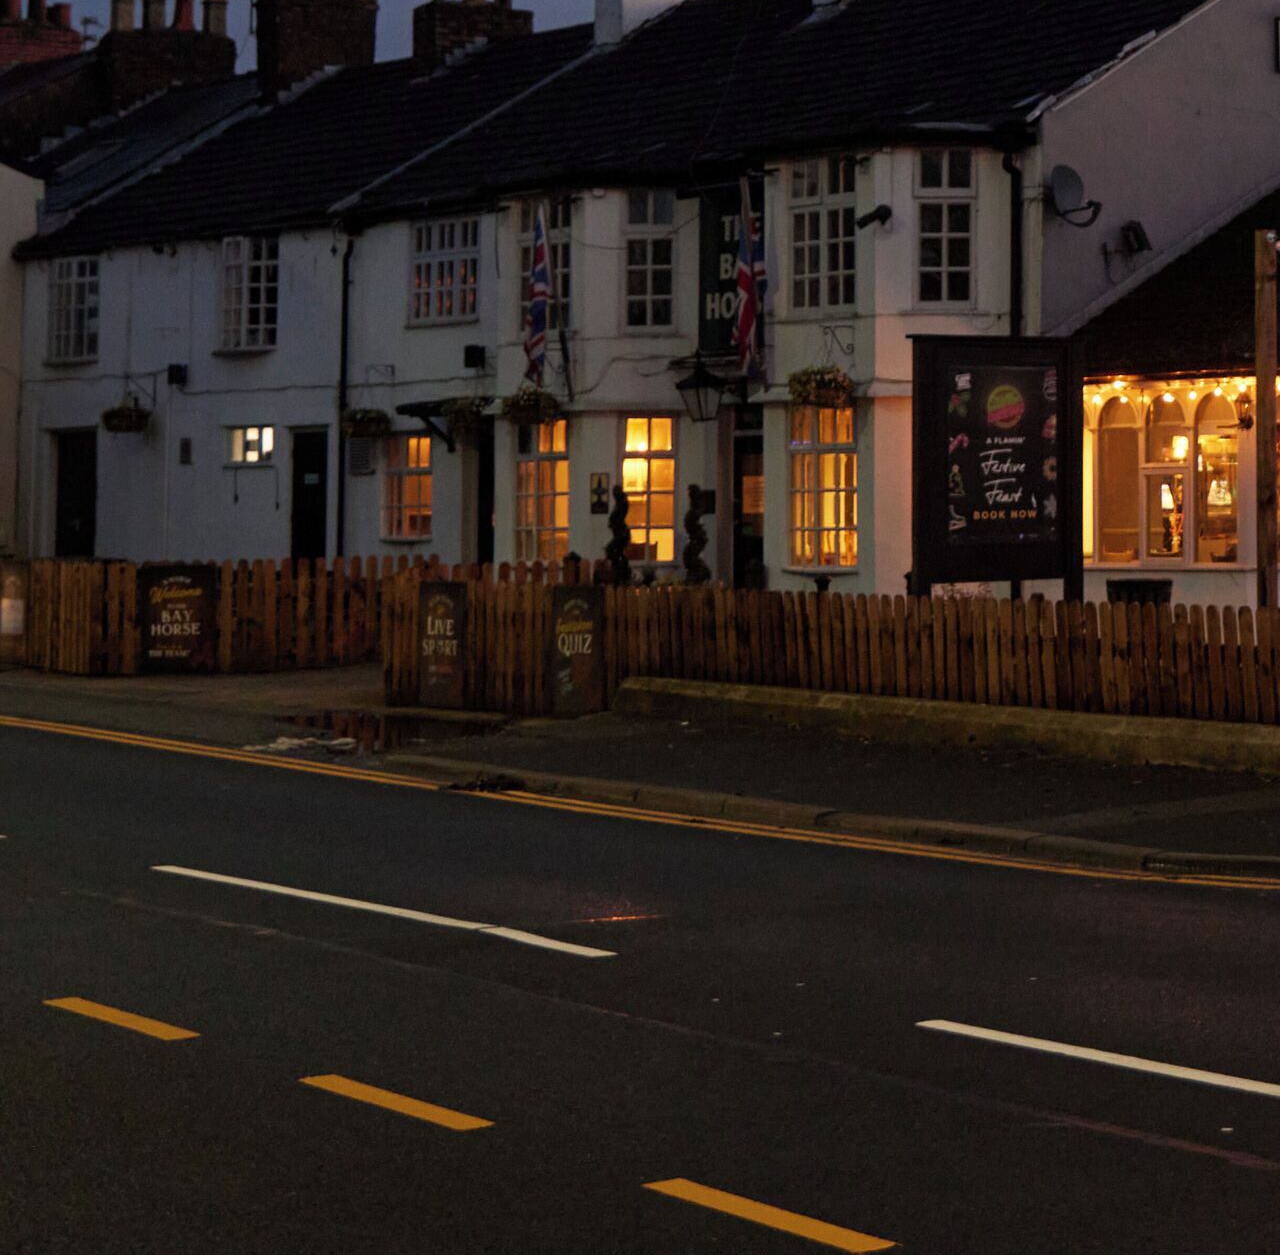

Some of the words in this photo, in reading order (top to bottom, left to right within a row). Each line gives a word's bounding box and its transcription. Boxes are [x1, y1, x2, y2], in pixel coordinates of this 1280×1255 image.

[972, 509, 1006, 521] BOOK
[1010, 509, 1038, 520] NOW
[160, 609, 193, 623] BAY
[150, 622, 200, 637] HORSE
[426, 615, 455, 636] LIVE
[422, 639, 458, 657] SPORT
[558, 633, 592, 657] QUIZ
